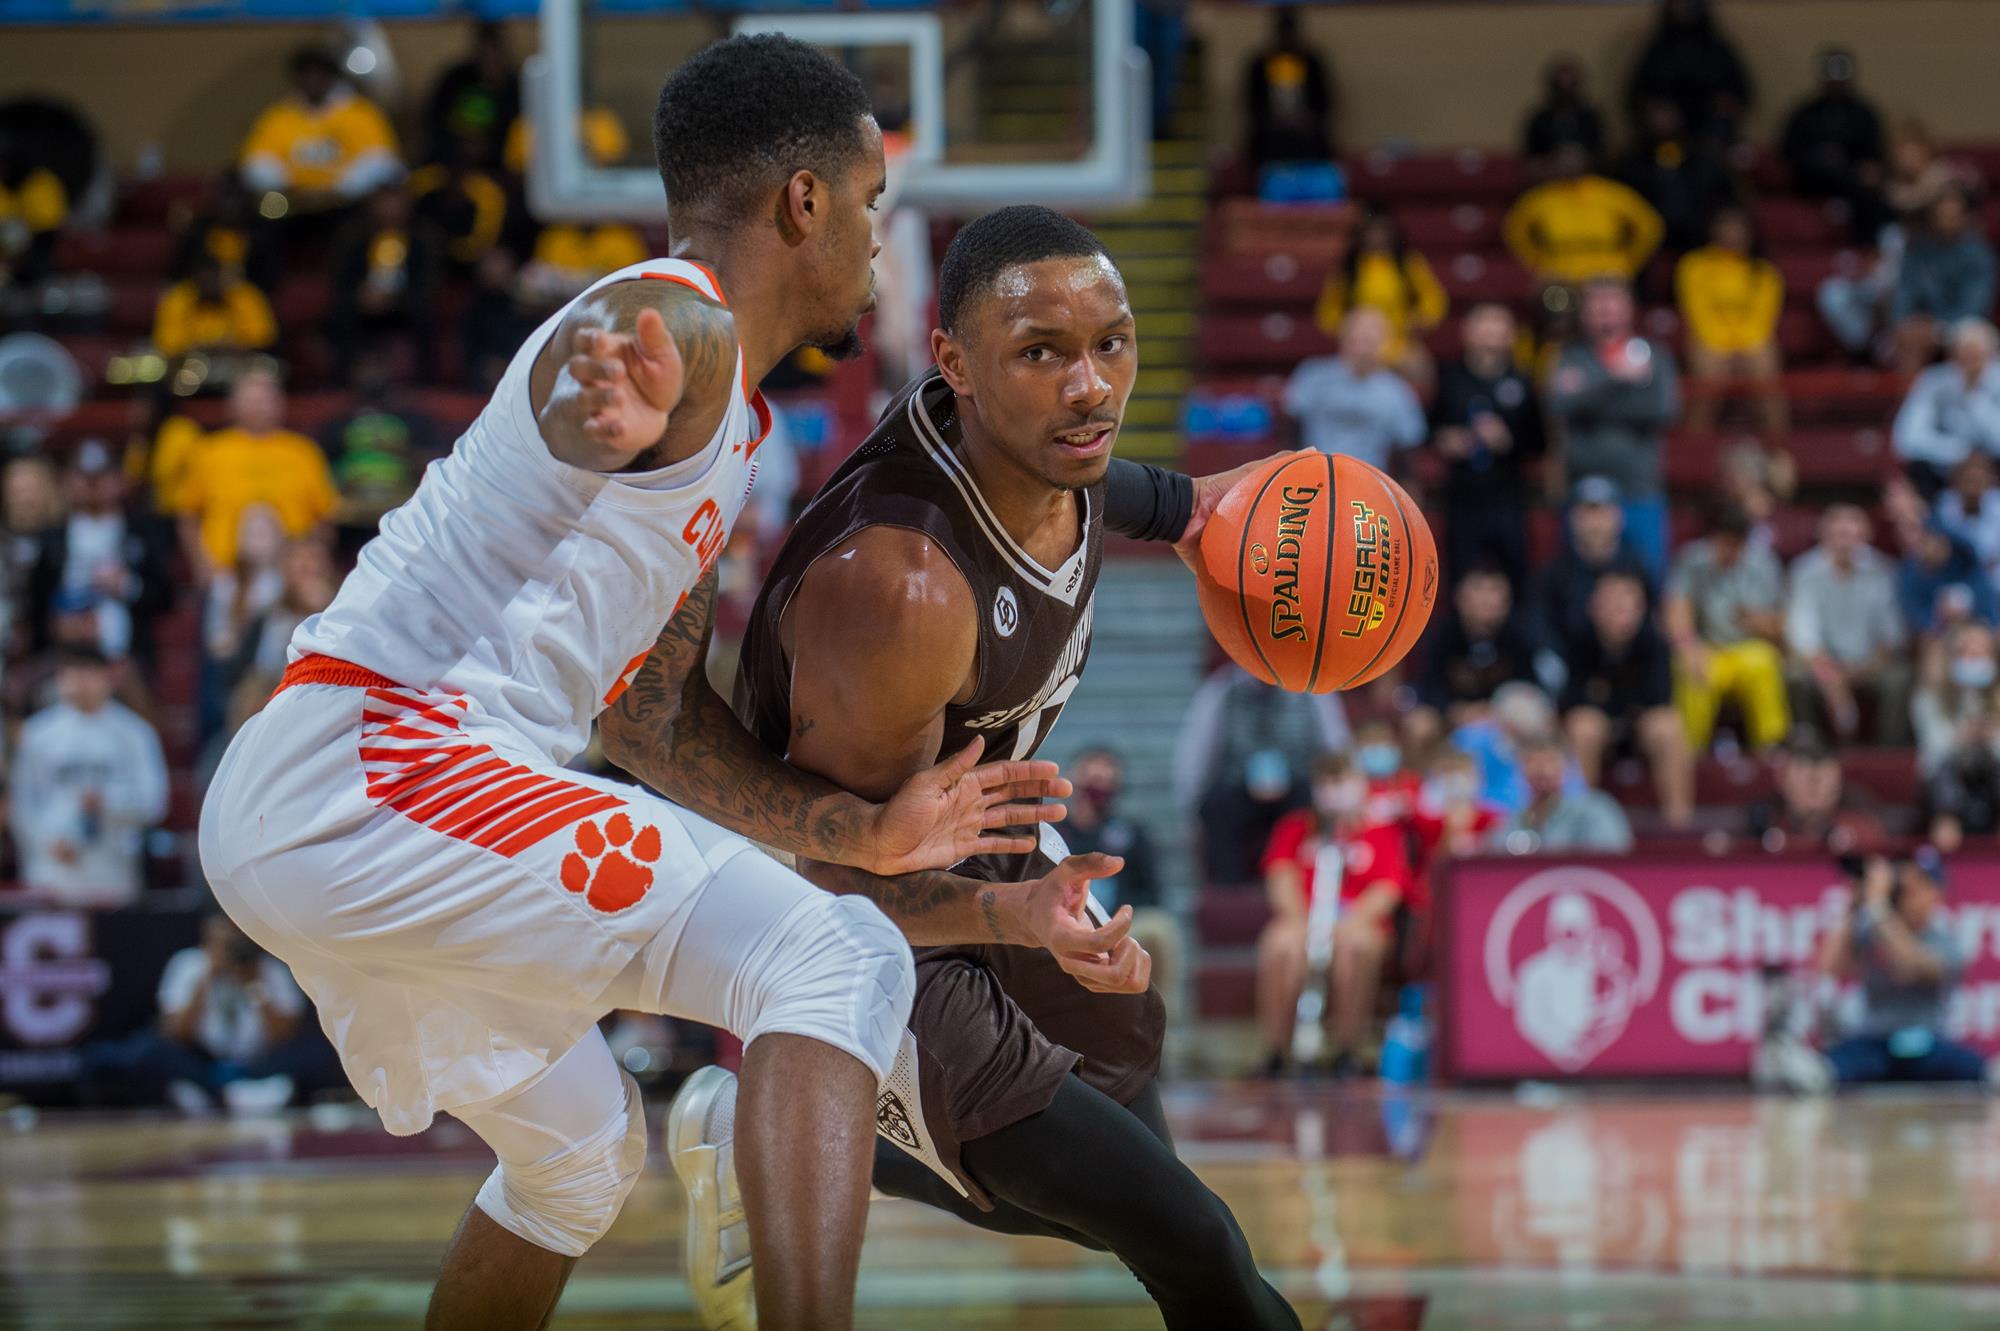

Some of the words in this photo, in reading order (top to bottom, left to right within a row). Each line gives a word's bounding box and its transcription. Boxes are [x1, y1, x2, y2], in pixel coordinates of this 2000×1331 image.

[1270, 486, 1320, 643] SPALDING
[1340, 500, 1377, 638] LEGACY
[1377, 514, 1391, 598] 1000
[1388, 577, 1398, 608] OFFICIAL
